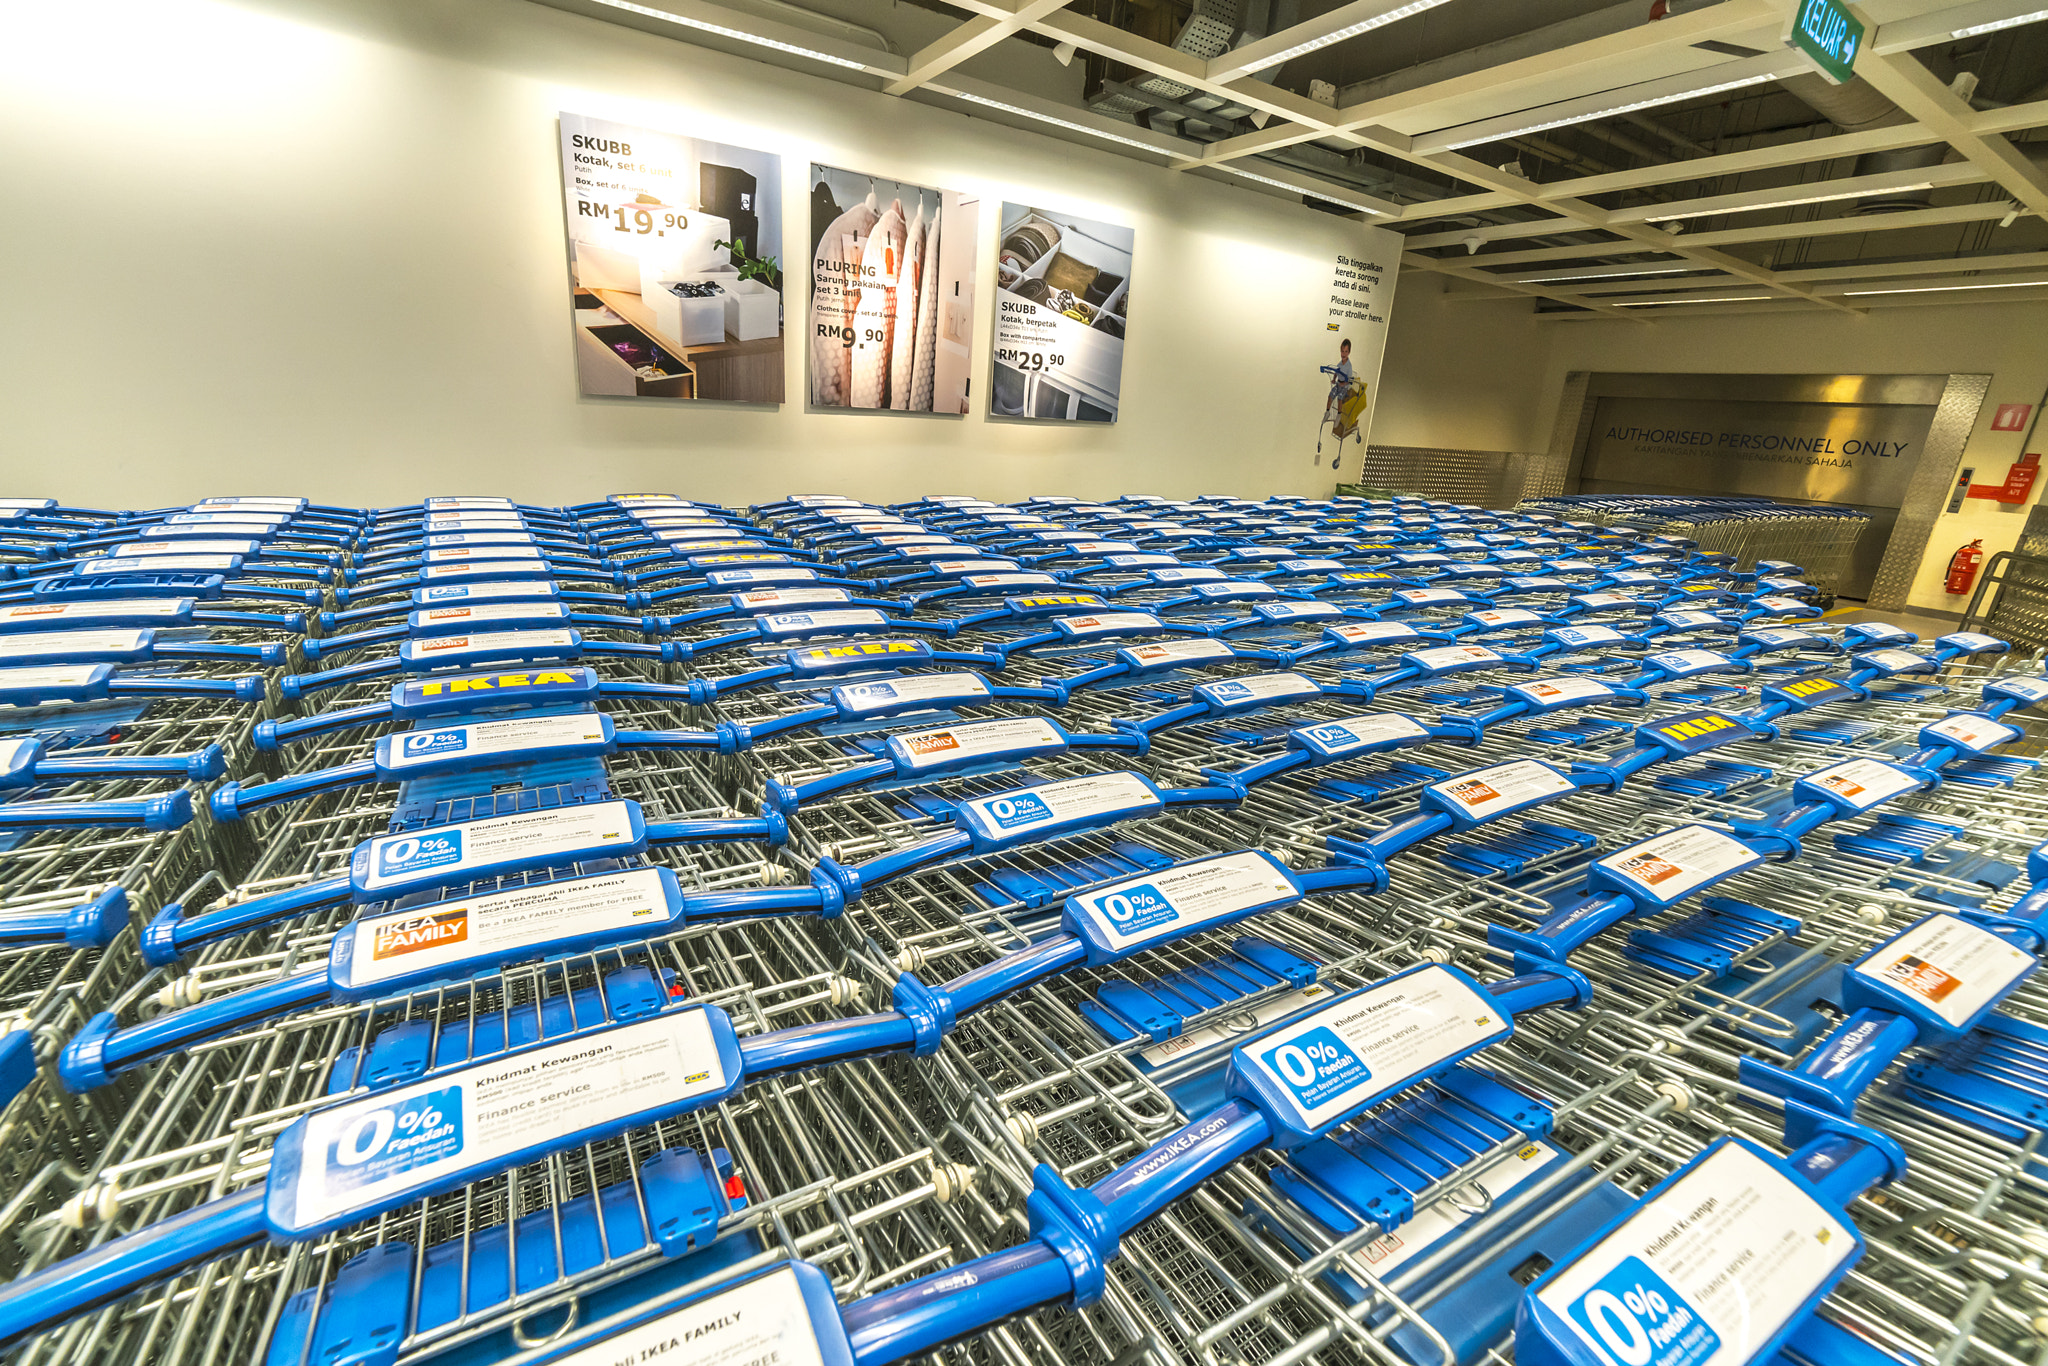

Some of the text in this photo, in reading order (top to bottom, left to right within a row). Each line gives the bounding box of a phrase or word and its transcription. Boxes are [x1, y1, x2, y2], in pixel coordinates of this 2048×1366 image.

[1801, 0, 1847, 60] KELUAR
[572, 134, 631, 156] SKUBB
[574, 153, 672, 177] Kotak, set 6 unit
[575, 165, 592, 173] Putih
[576, 177, 594, 186] Box,
[817, 259, 876, 277] PLURING
[1337, 255, 1383, 272] Sila tinggalkan
[816, 274, 889, 291] Sarung pakaian,
[1335, 267, 1379, 285] kereta sorong
[817, 286, 831, 294] set
[842, 289, 860, 297] unit
[1334, 280, 1371, 293] anda di sini.
[1002, 302, 1036, 314] SKUBB
[1331, 295, 1369, 309] Please leave
[1001, 315, 1057, 328] Kotak, berpetak
[1329, 308, 1383, 323] your stroller here.
[1606, 427, 1713, 445] AUTHORISED
[1718, 433, 1835, 454] PERSONNEL
[1842, 440, 1908, 458] ONLY
[1805, 456, 1853, 469] SAHAJA
[1020, 596, 1097, 607] IKEA
[808, 642, 919, 660] IKEA
[422, 672, 576, 696] IKEA
[1781, 678, 1839, 698] IKEA
[1660, 715, 1736, 742] IKEA
[408, 734, 457, 749] 0%
[907, 735, 937, 744] IKEA
[912, 738, 953, 751] FAMILY
[1458, 785, 1493, 801] FAMILY
[992, 799, 1034, 819] 0%
[1017, 805, 1044, 816] Faedah
[470, 814, 558, 832] Khidmat Kewangan
[470, 832, 542, 848] Finance service
[384, 838, 449, 864] 0%
[416, 847, 456, 859] Faedah
[1157, 875, 1187, 886] Khidmat
[478, 879, 626, 910] Sertai sebagai ahli IKEA FAMILY
[1174, 884, 1227, 904] Finance service
[478, 895, 559, 915] secara PERCUMA
[478, 921, 493, 929] Be
[503, 914, 526, 924] IKEA
[528, 907, 566, 921] FAMILY
[567, 900, 604, 914] member
[605, 898, 621, 907] for
[622, 894, 644, 904] FREE
[1104, 894, 1156, 922] 0%
[1136, 902, 1167, 916] Faedah
[378, 921, 464, 952] FAMILY
[380, 916, 437, 938] IKEA
[1333, 1010, 1367, 1028] Khidmat
[1361, 1023, 1420, 1054] Finance service
[476, 1044, 613, 1088] Khidmat Kewangan
[1275, 1041, 1338, 1087] 0%
[1318, 1054, 1354, 1078] Faedah
[1301, 1065, 1362, 1099] Pelan Bayaran Ansuran
[478, 1083, 591, 1123] Finance service
[336, 1105, 443, 1166] 0%
[386, 1123, 455, 1154] Faedah
[367, 1152, 411, 1171] Bayaran
[413, 1137, 456, 1156] Ansuran
[1134, 1117, 1227, 1177] www.IKEA.com
[1520, 1147, 1535, 1159] IKEA
[1643, 1226, 1683, 1258] Khidmat
[1584, 1283, 1670, 1366] 0%
[640, 1310, 742, 1362] IKEA FAMILY
[743, 1350, 779, 1366] REE
